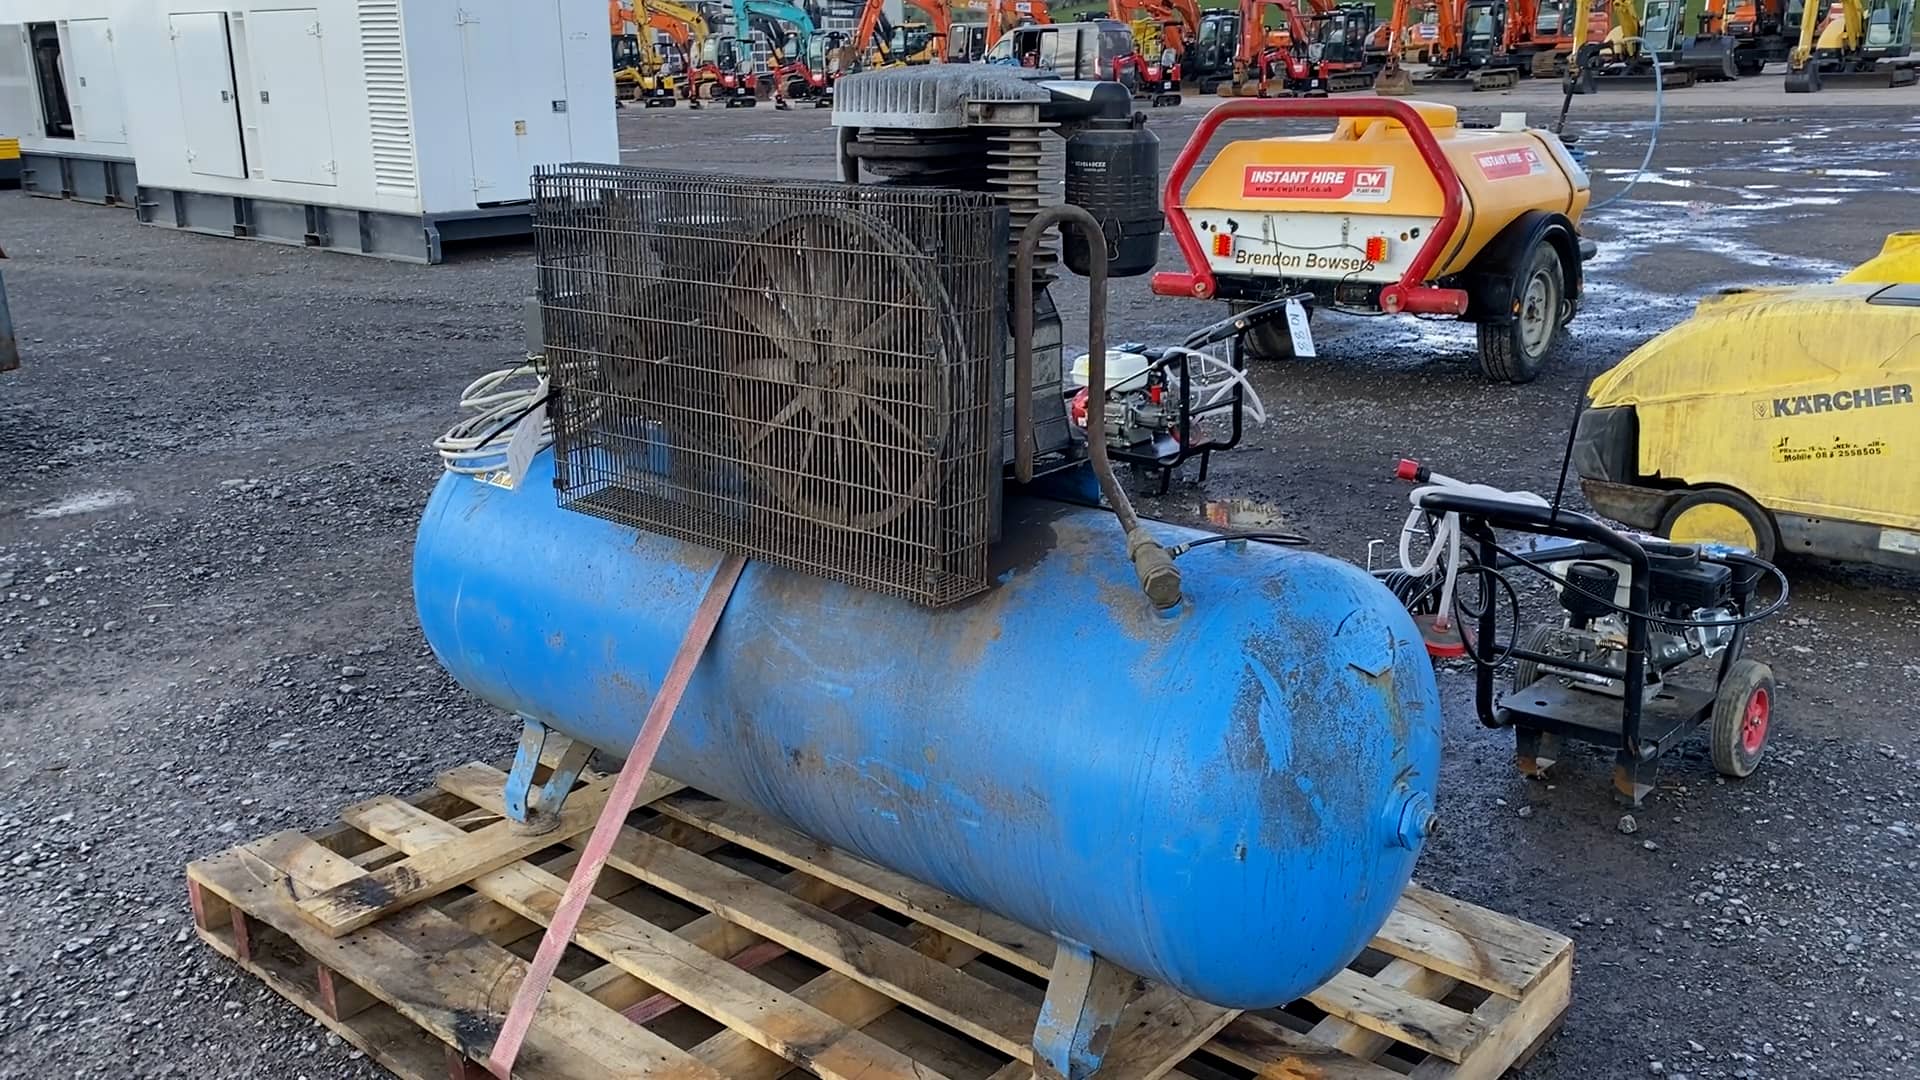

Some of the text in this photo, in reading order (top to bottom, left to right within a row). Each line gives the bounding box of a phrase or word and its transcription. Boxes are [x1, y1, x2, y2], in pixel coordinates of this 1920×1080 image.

[1250, 171, 1346, 184] INSTANT HIRE
[1356, 172, 1382, 186] CW
[1235, 250, 1376, 272] Brendon Bowsers
[1773, 383, 1913, 418] KÄRCHER
